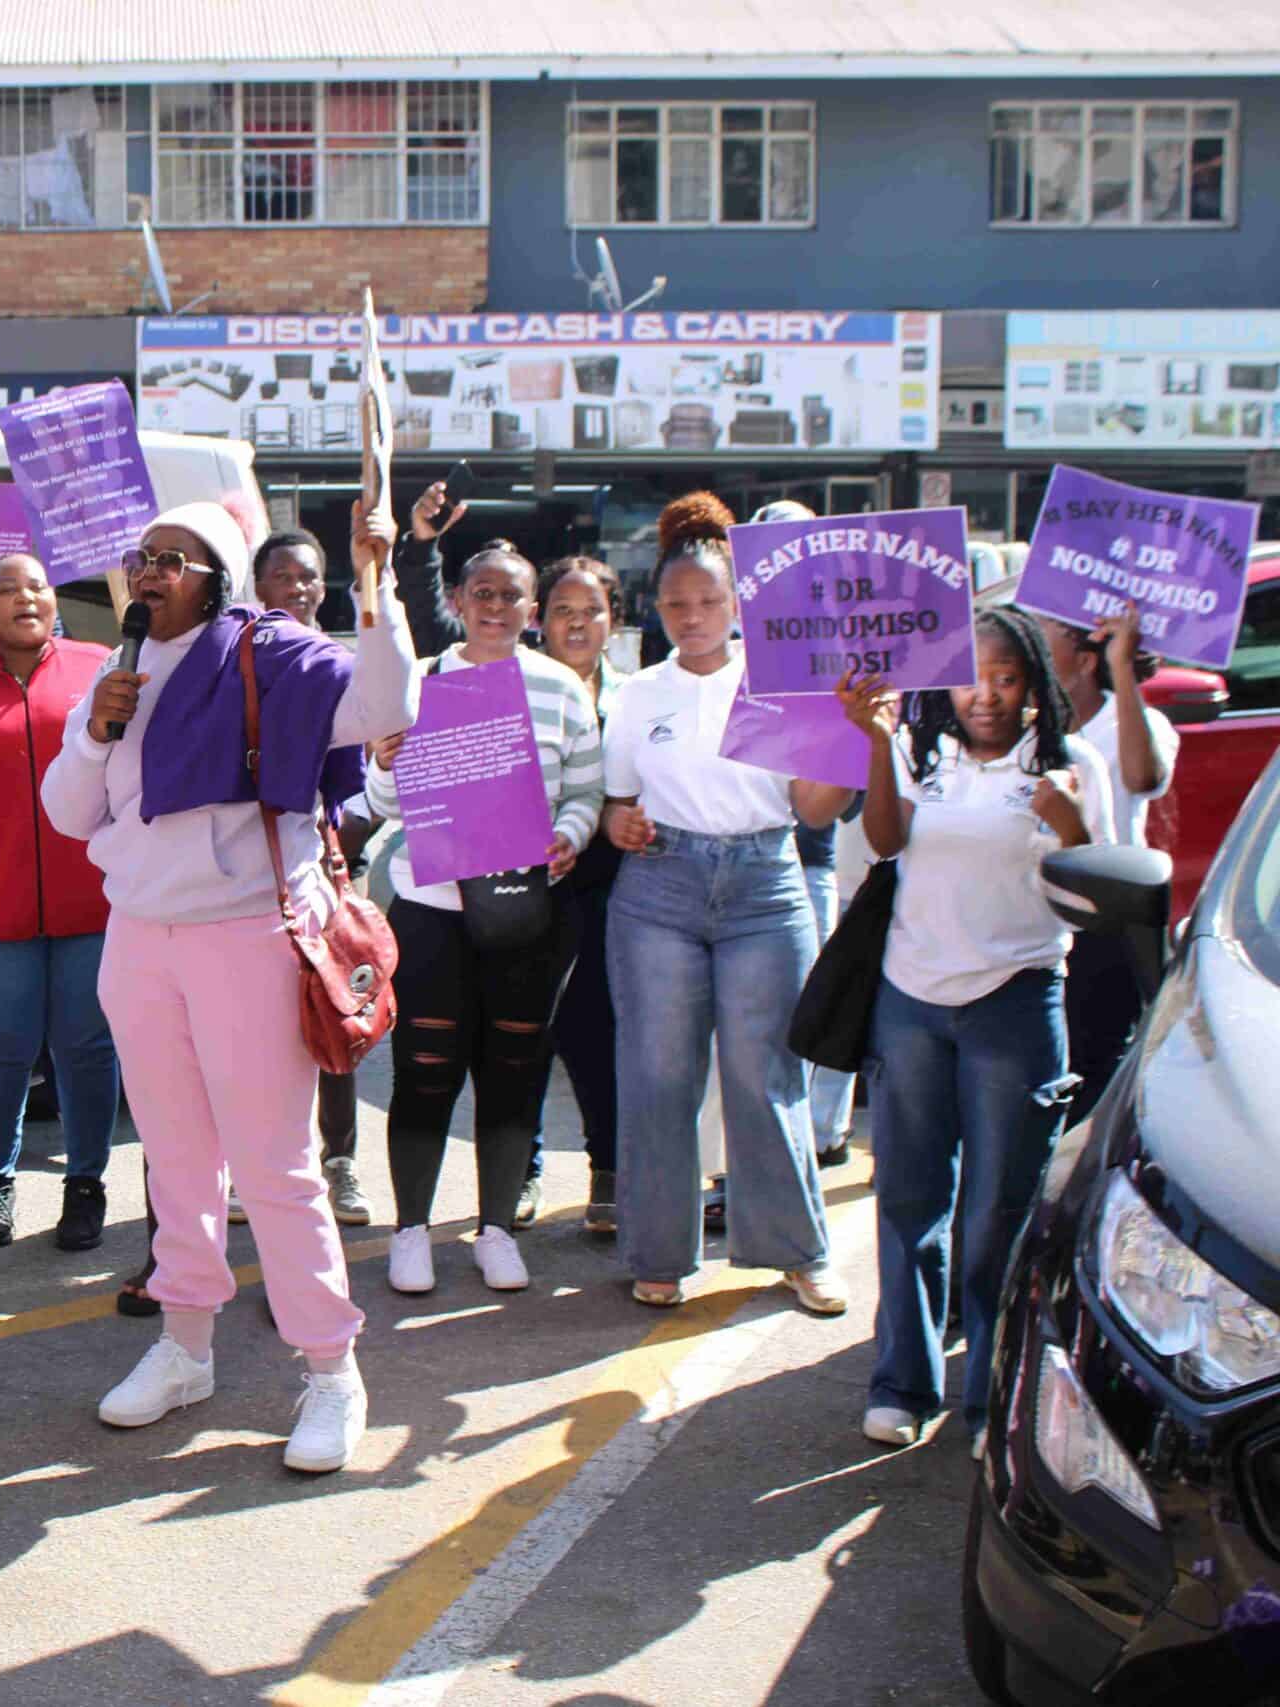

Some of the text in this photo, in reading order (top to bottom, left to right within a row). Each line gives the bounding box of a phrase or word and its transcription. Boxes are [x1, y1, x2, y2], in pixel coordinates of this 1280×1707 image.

[226, 312, 851, 345] DISCOUNT CASH & CARRY
[1066, 499, 1119, 521] SAY
[1124, 502, 1185, 528] HER
[735, 528, 969, 600] # SAY HER NAME
[1108, 535, 1180, 573] # DR
[835, 577, 875, 604] DR
[1048, 545, 1219, 614] NONDUMISO
[763, 609, 941, 641] NONDUMISO
[1082, 588, 1170, 640] NKSI
